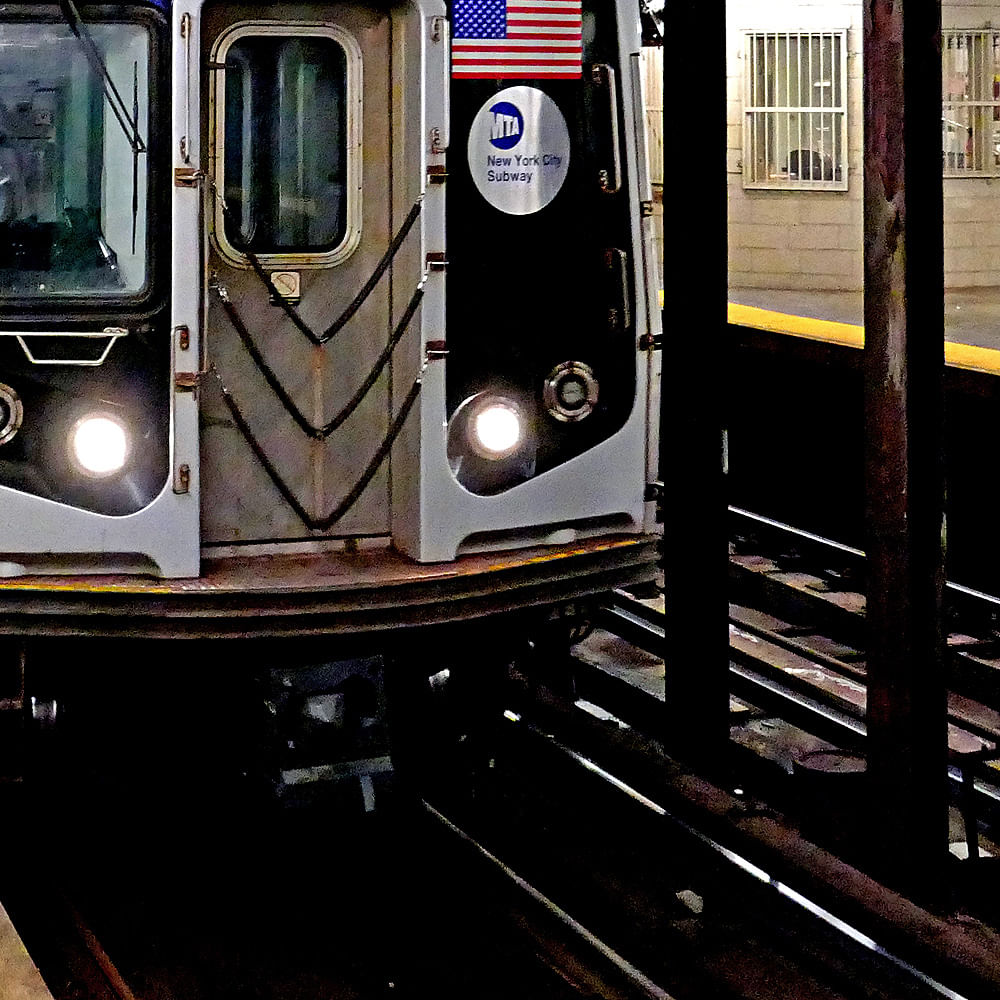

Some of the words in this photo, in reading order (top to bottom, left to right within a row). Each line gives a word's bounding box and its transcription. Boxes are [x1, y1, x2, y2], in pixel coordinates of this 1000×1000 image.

[488, 110, 520, 140] MTA
[487, 155, 512, 167] New
[514, 155, 540, 167] York
[542, 154, 562, 168] City
[487, 170, 533, 183] Subway
